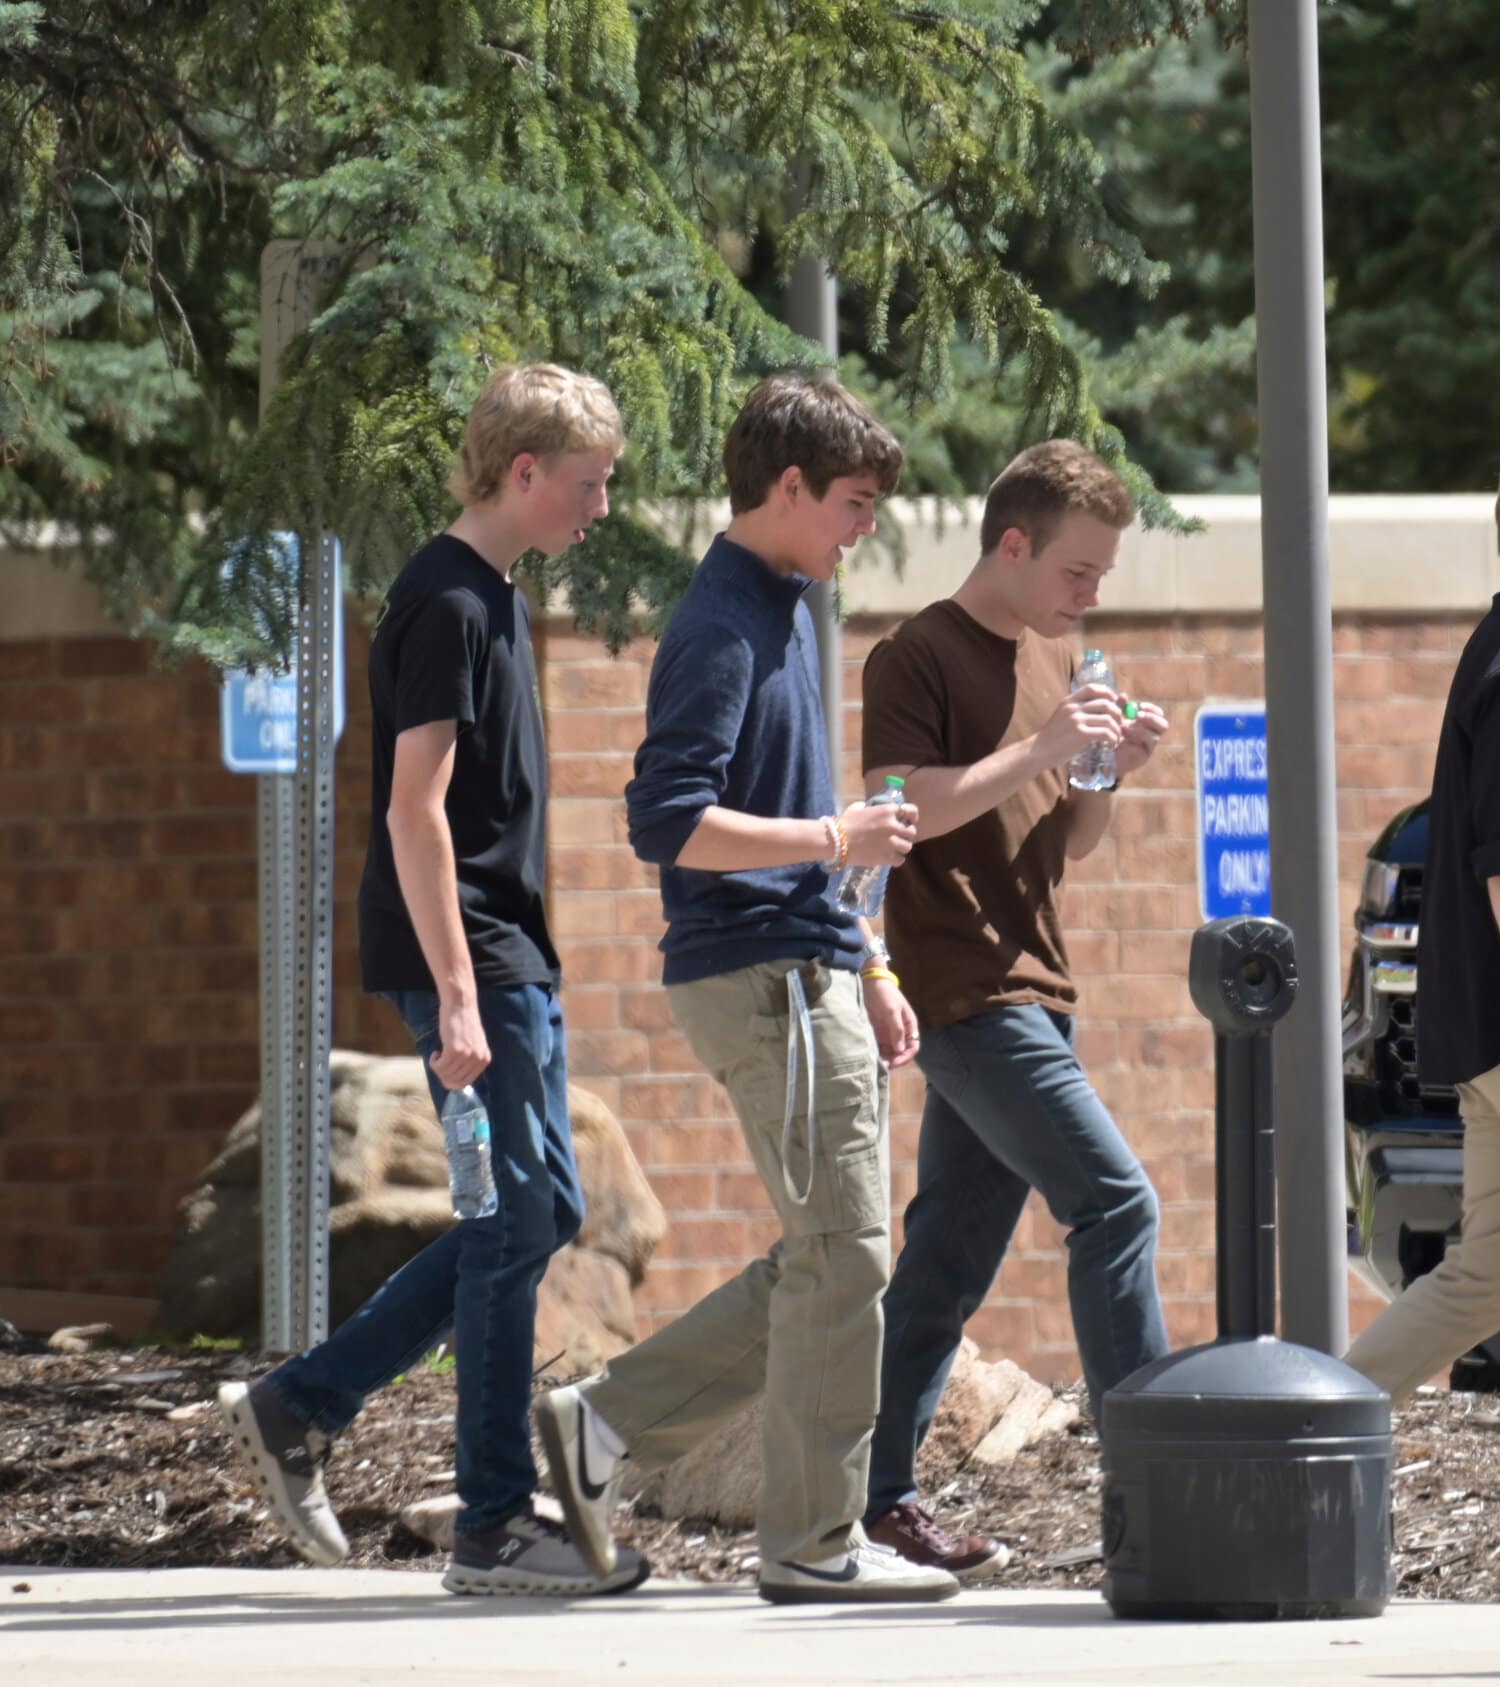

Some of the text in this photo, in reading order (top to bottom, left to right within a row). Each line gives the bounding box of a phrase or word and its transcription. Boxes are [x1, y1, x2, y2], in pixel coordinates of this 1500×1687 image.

[1202, 738, 1267, 779] EXPRES
[1205, 794, 1268, 835] PARKIN
[1219, 850, 1268, 896] ONLY
